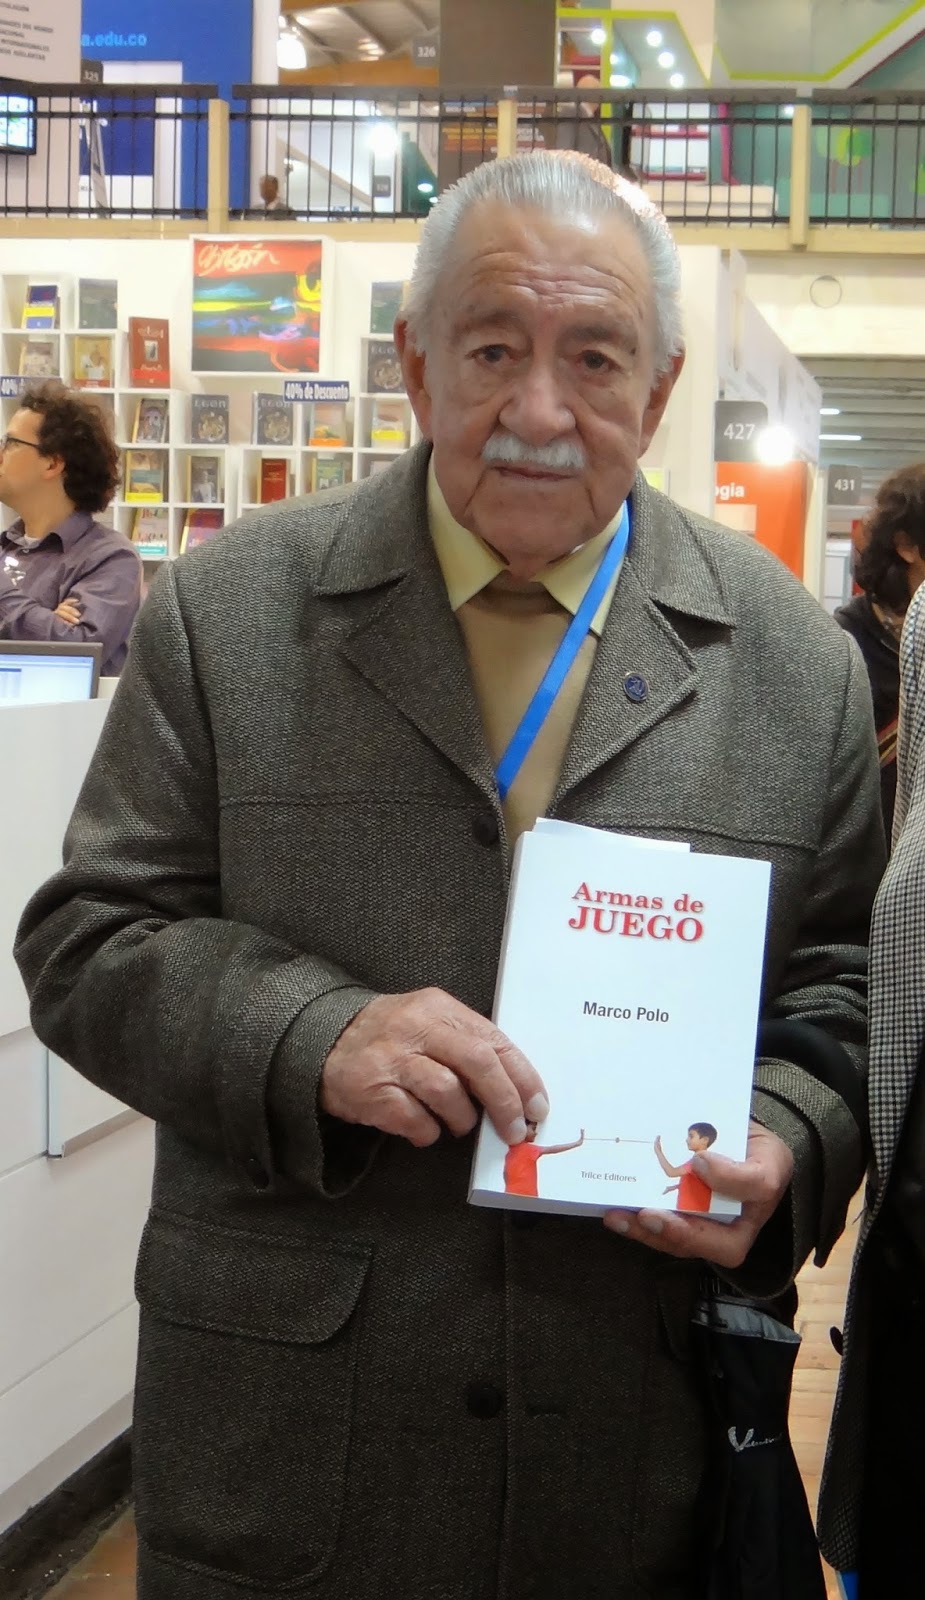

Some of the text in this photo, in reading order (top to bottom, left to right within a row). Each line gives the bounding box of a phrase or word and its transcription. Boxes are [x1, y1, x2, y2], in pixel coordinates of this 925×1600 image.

[417, 46, 436, 58] 326
[285, 382, 348, 400] 40% de Descuento
[723, 423, 755, 440] 427
[834, 479, 855, 491] 431
[571, 882, 704, 913] Armas de
[568, 905, 704, 942] JUEGO
[583, 1001, 669, 1022] Marco Polo
[604, 1172, 637, 1182] Editores
